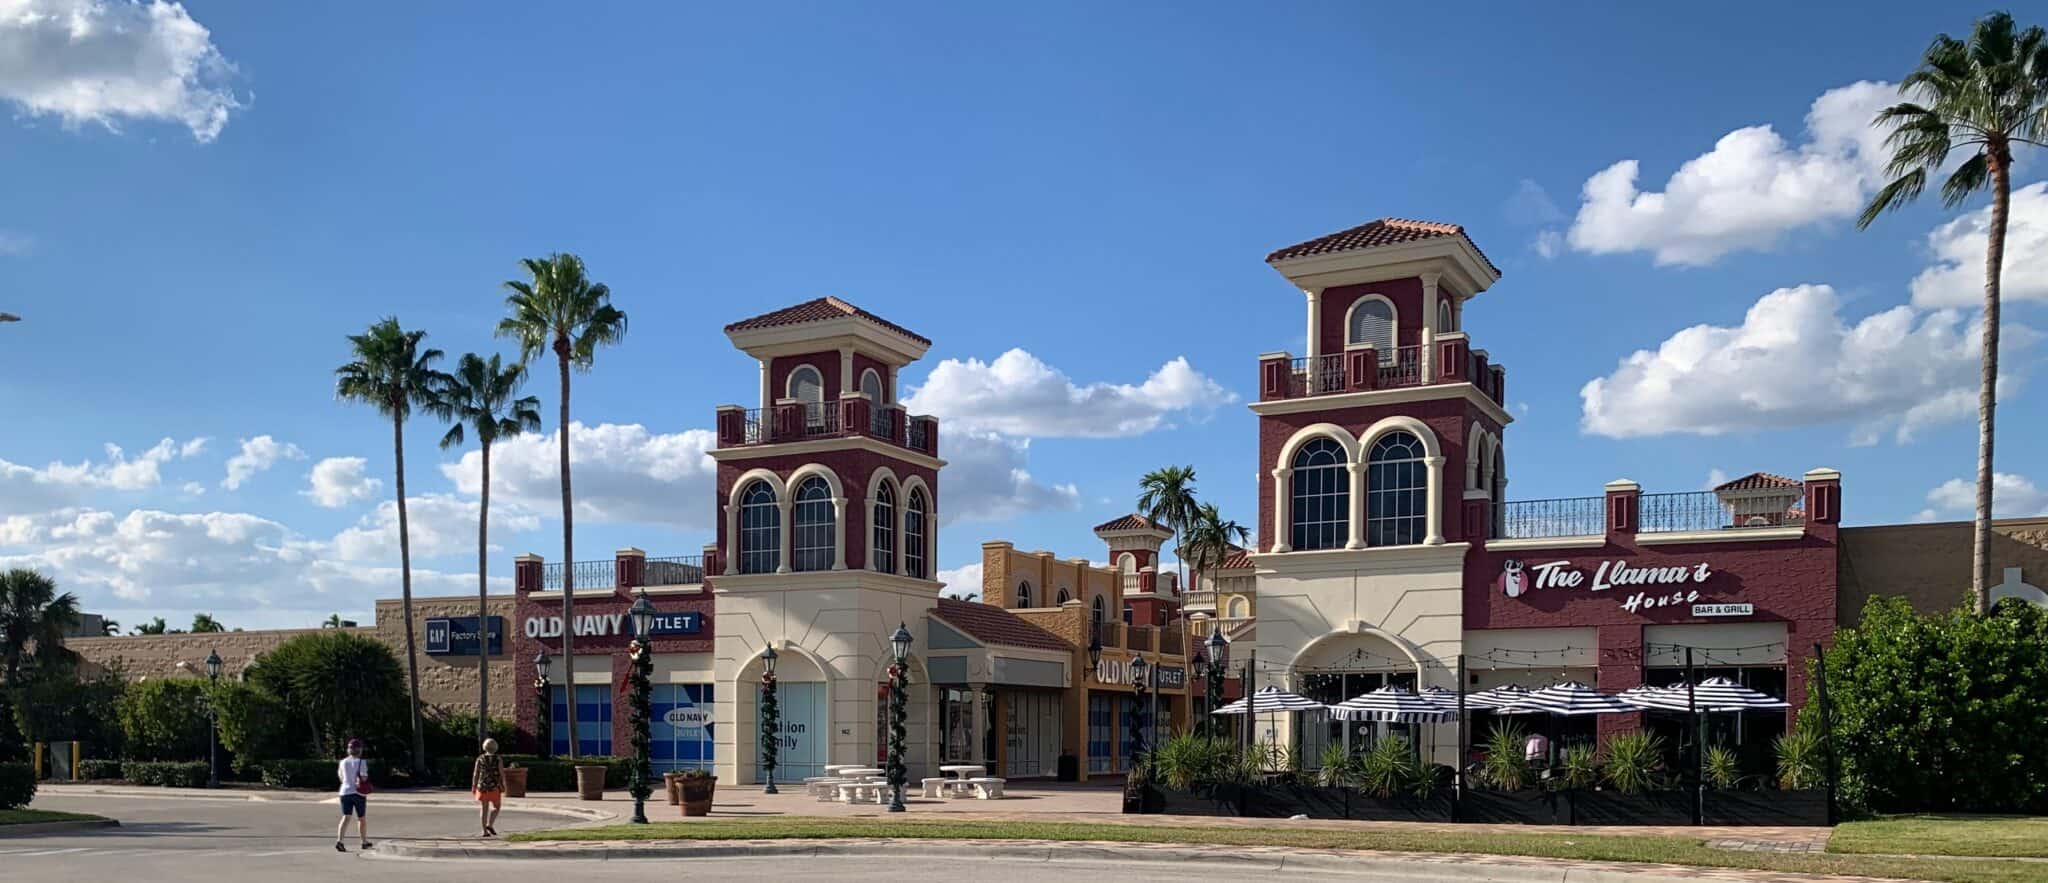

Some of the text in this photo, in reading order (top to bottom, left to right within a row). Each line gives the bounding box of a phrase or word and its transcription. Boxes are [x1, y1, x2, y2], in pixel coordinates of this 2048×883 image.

[1532, 560, 1712, 591] The Llama's
[1620, 590, 1700, 613] House
[1694, 604, 1750, 614] BAR & GRILL
[430, 629, 445, 643] GAP
[451, 631, 476, 641] Factory
[525, 613, 625, 638] OLD NAVY
[1096, 658, 1119, 683] OLD
